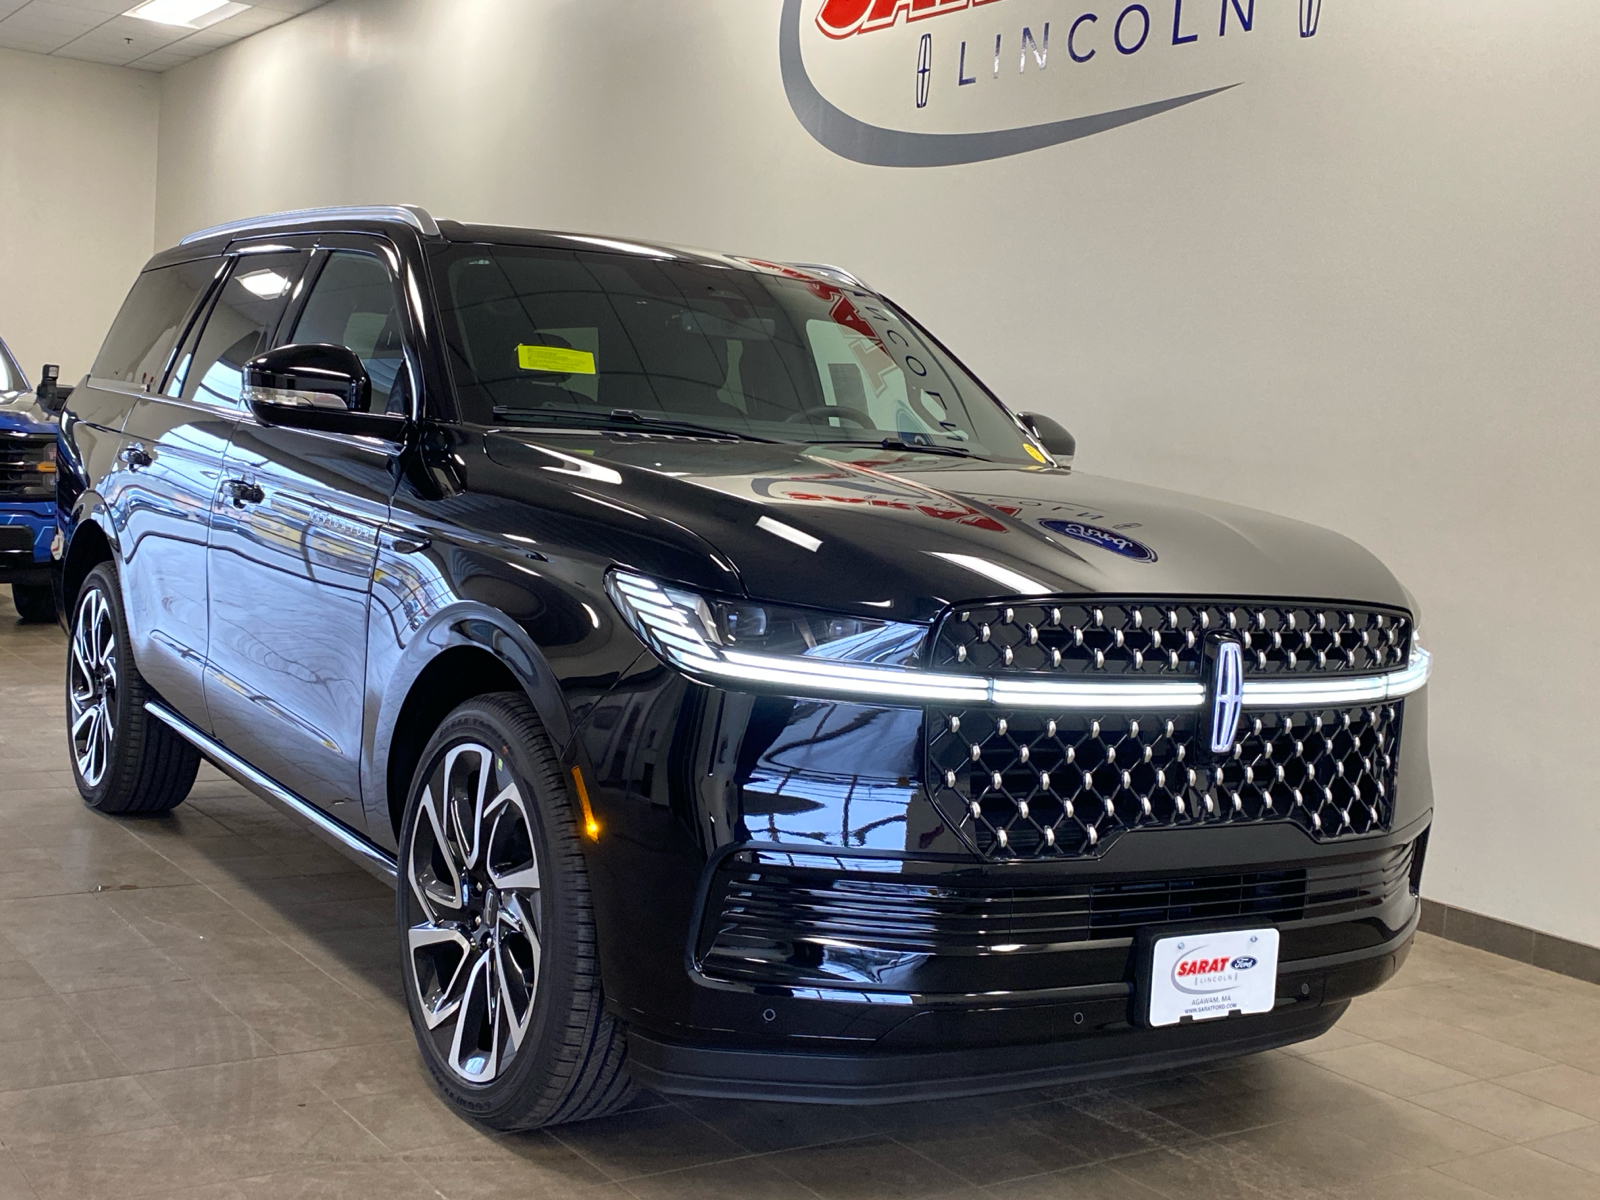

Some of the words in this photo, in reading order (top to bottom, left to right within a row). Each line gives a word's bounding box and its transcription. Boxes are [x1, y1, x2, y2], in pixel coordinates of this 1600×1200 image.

[957, 0, 1255, 87] LINCOLN
[1177, 956, 1230, 976] SARAT
[1233, 957, 1255, 970] Ford
[1200, 975, 1232, 984] LINCOLN
[1191, 996, 1220, 1006] AGAWAM,
[1221, 995, 1231, 1003] MA
